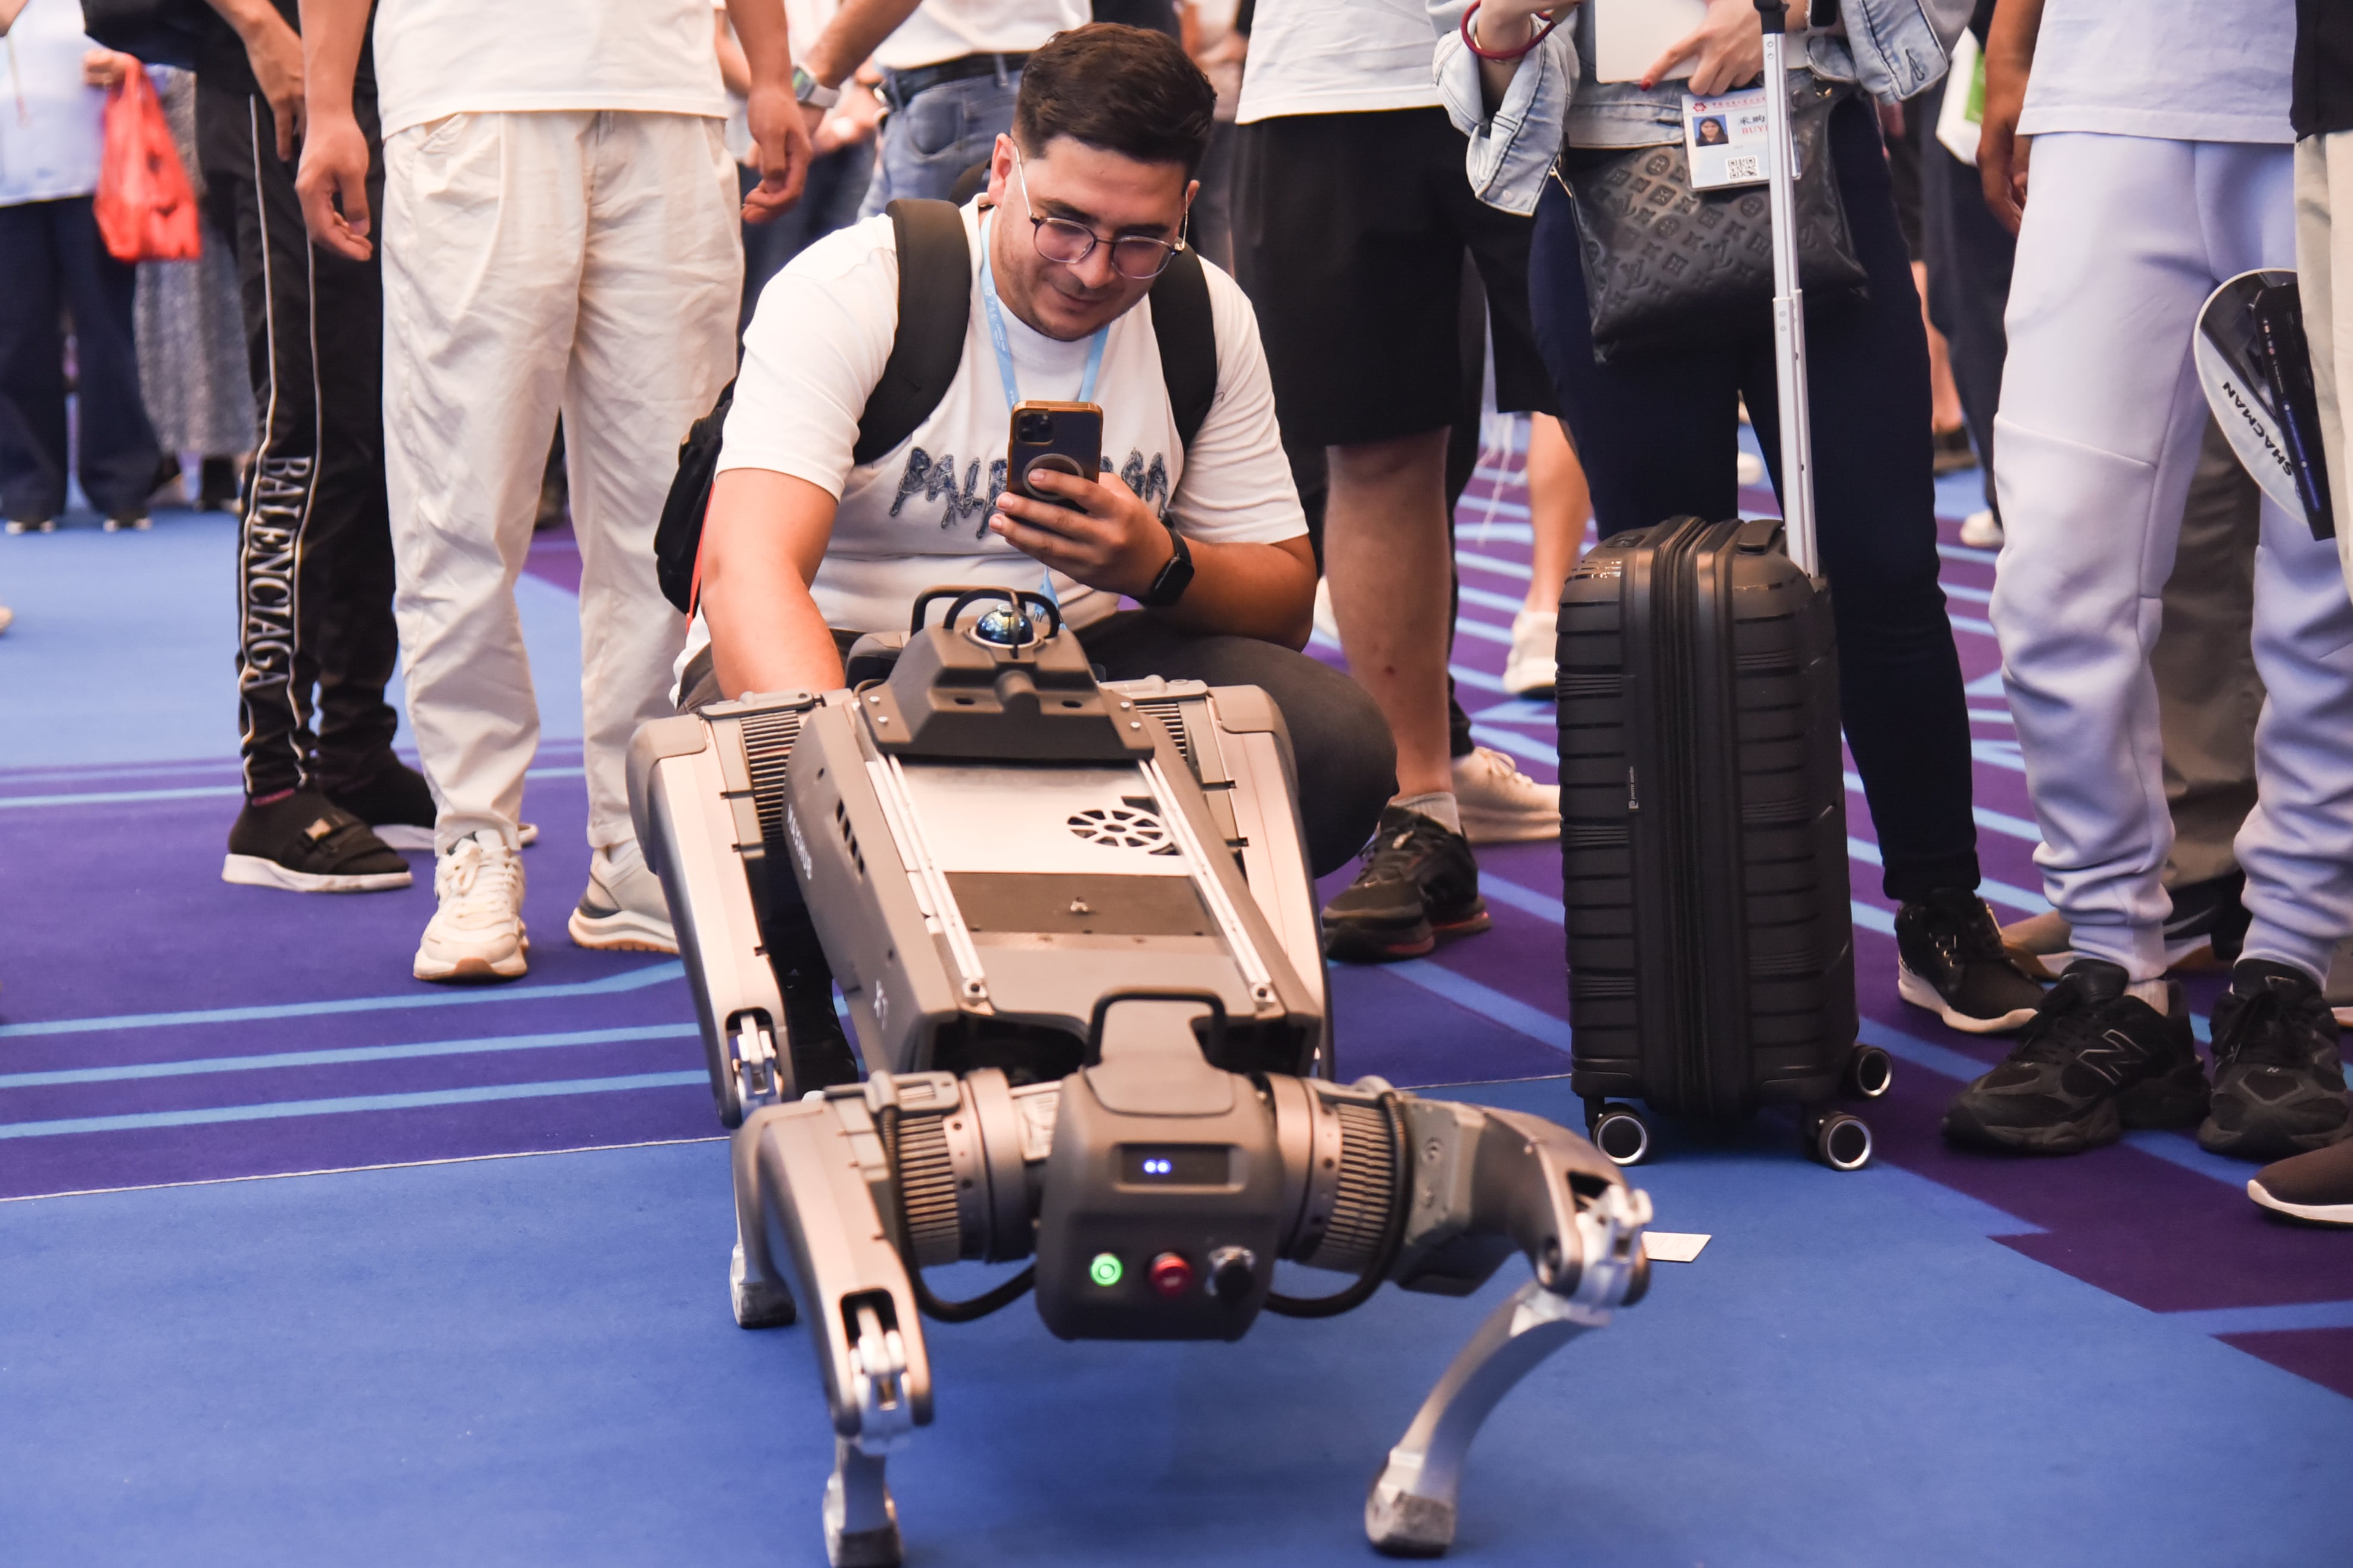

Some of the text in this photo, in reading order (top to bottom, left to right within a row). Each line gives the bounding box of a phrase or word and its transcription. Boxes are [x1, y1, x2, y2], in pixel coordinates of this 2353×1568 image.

[2223, 381, 2293, 476] SHACMAN
[242, 456, 312, 691] BALENCIAGA
[787, 802, 813, 880] MAXHUB
